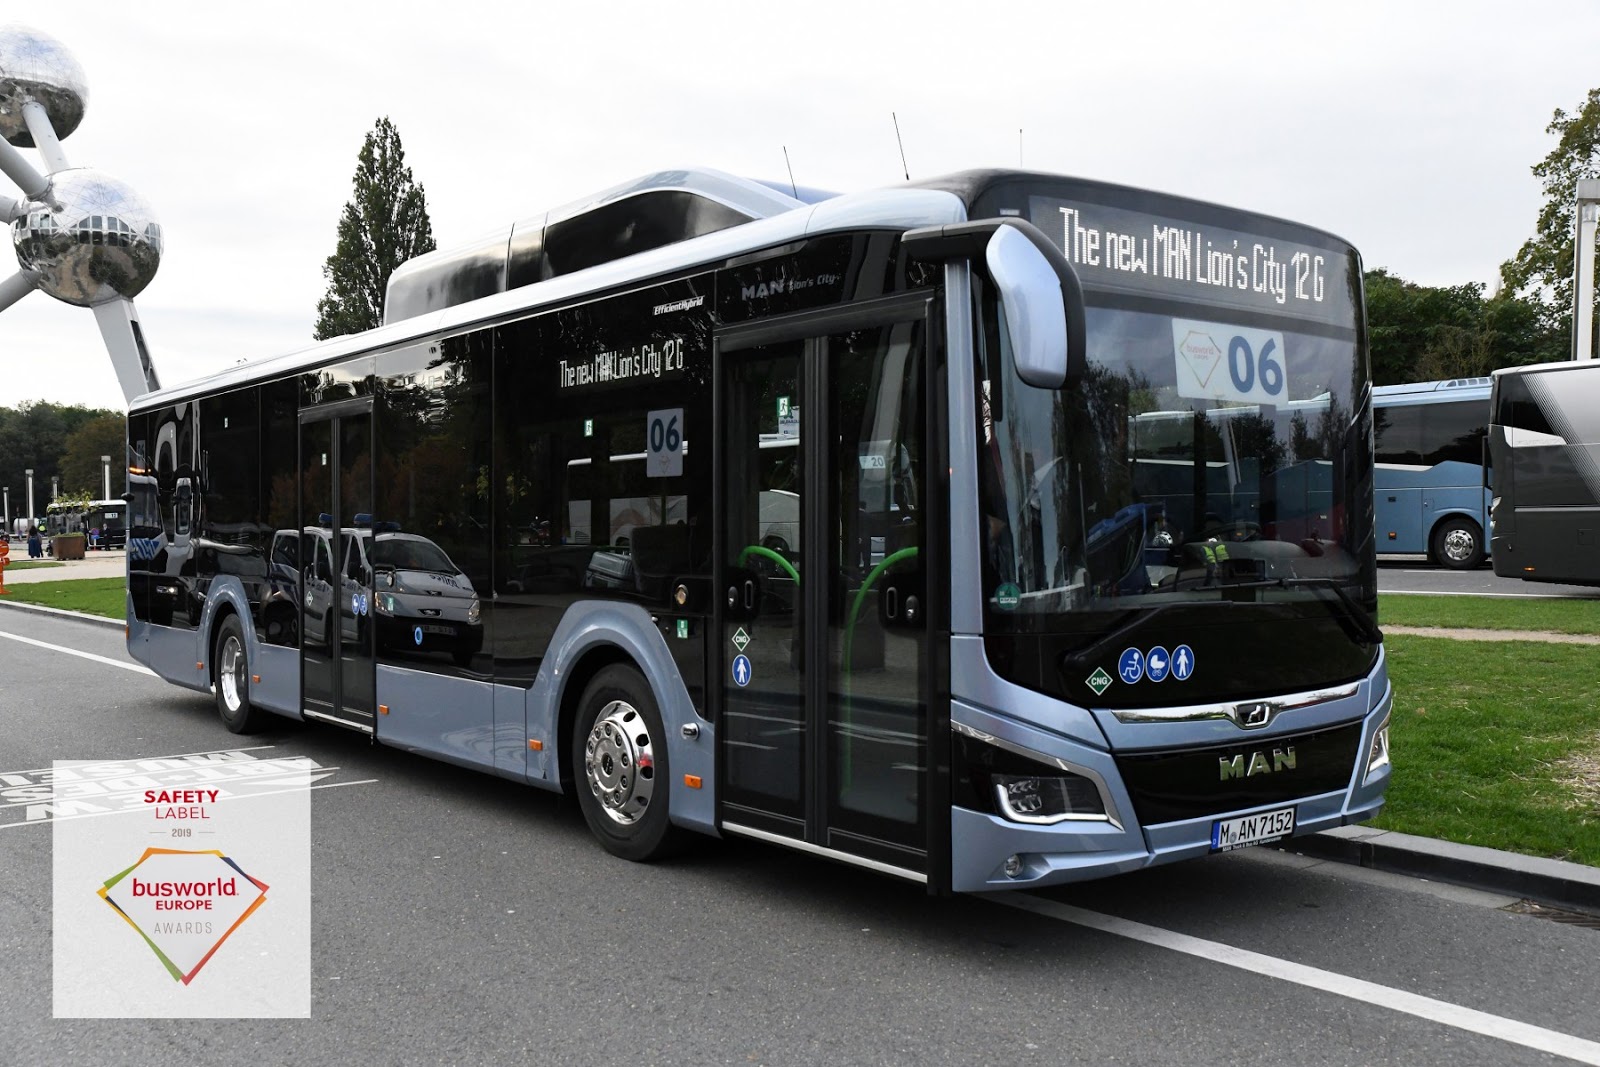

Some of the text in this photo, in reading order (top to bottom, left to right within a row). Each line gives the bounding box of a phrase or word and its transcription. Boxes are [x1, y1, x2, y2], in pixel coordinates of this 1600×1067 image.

[1059, 206, 1099, 266] The
[1106, 231, 1148, 274] new
[1153, 224, 1191, 281] MAN
[1196, 232, 1247, 290] Lion's
[1253, 243, 1286, 304] City
[1290, 251, 1309, 300] 12
[741, 279, 785, 301] MAN
[817, 273, 836, 285] City
[654, 295, 704, 316] EfficientHybrid
[560, 360, 575, 388] The
[576, 363, 594, 385] new
[595, 351, 612, 382] MAN
[613, 347, 640, 379] Lion's
[642, 343, 661, 378] City
[663, 340, 674, 371] 12
[1228, 335, 1283, 396] 06
[650, 415, 680, 453] 06
[871, 457, 884, 467] 20
[735, 635, 747, 643] CNG
[1091, 676, 1108, 686] CNG
[1219, 747, 1296, 781] MAN
[1220, 811, 1292, 844] M AN 7152
